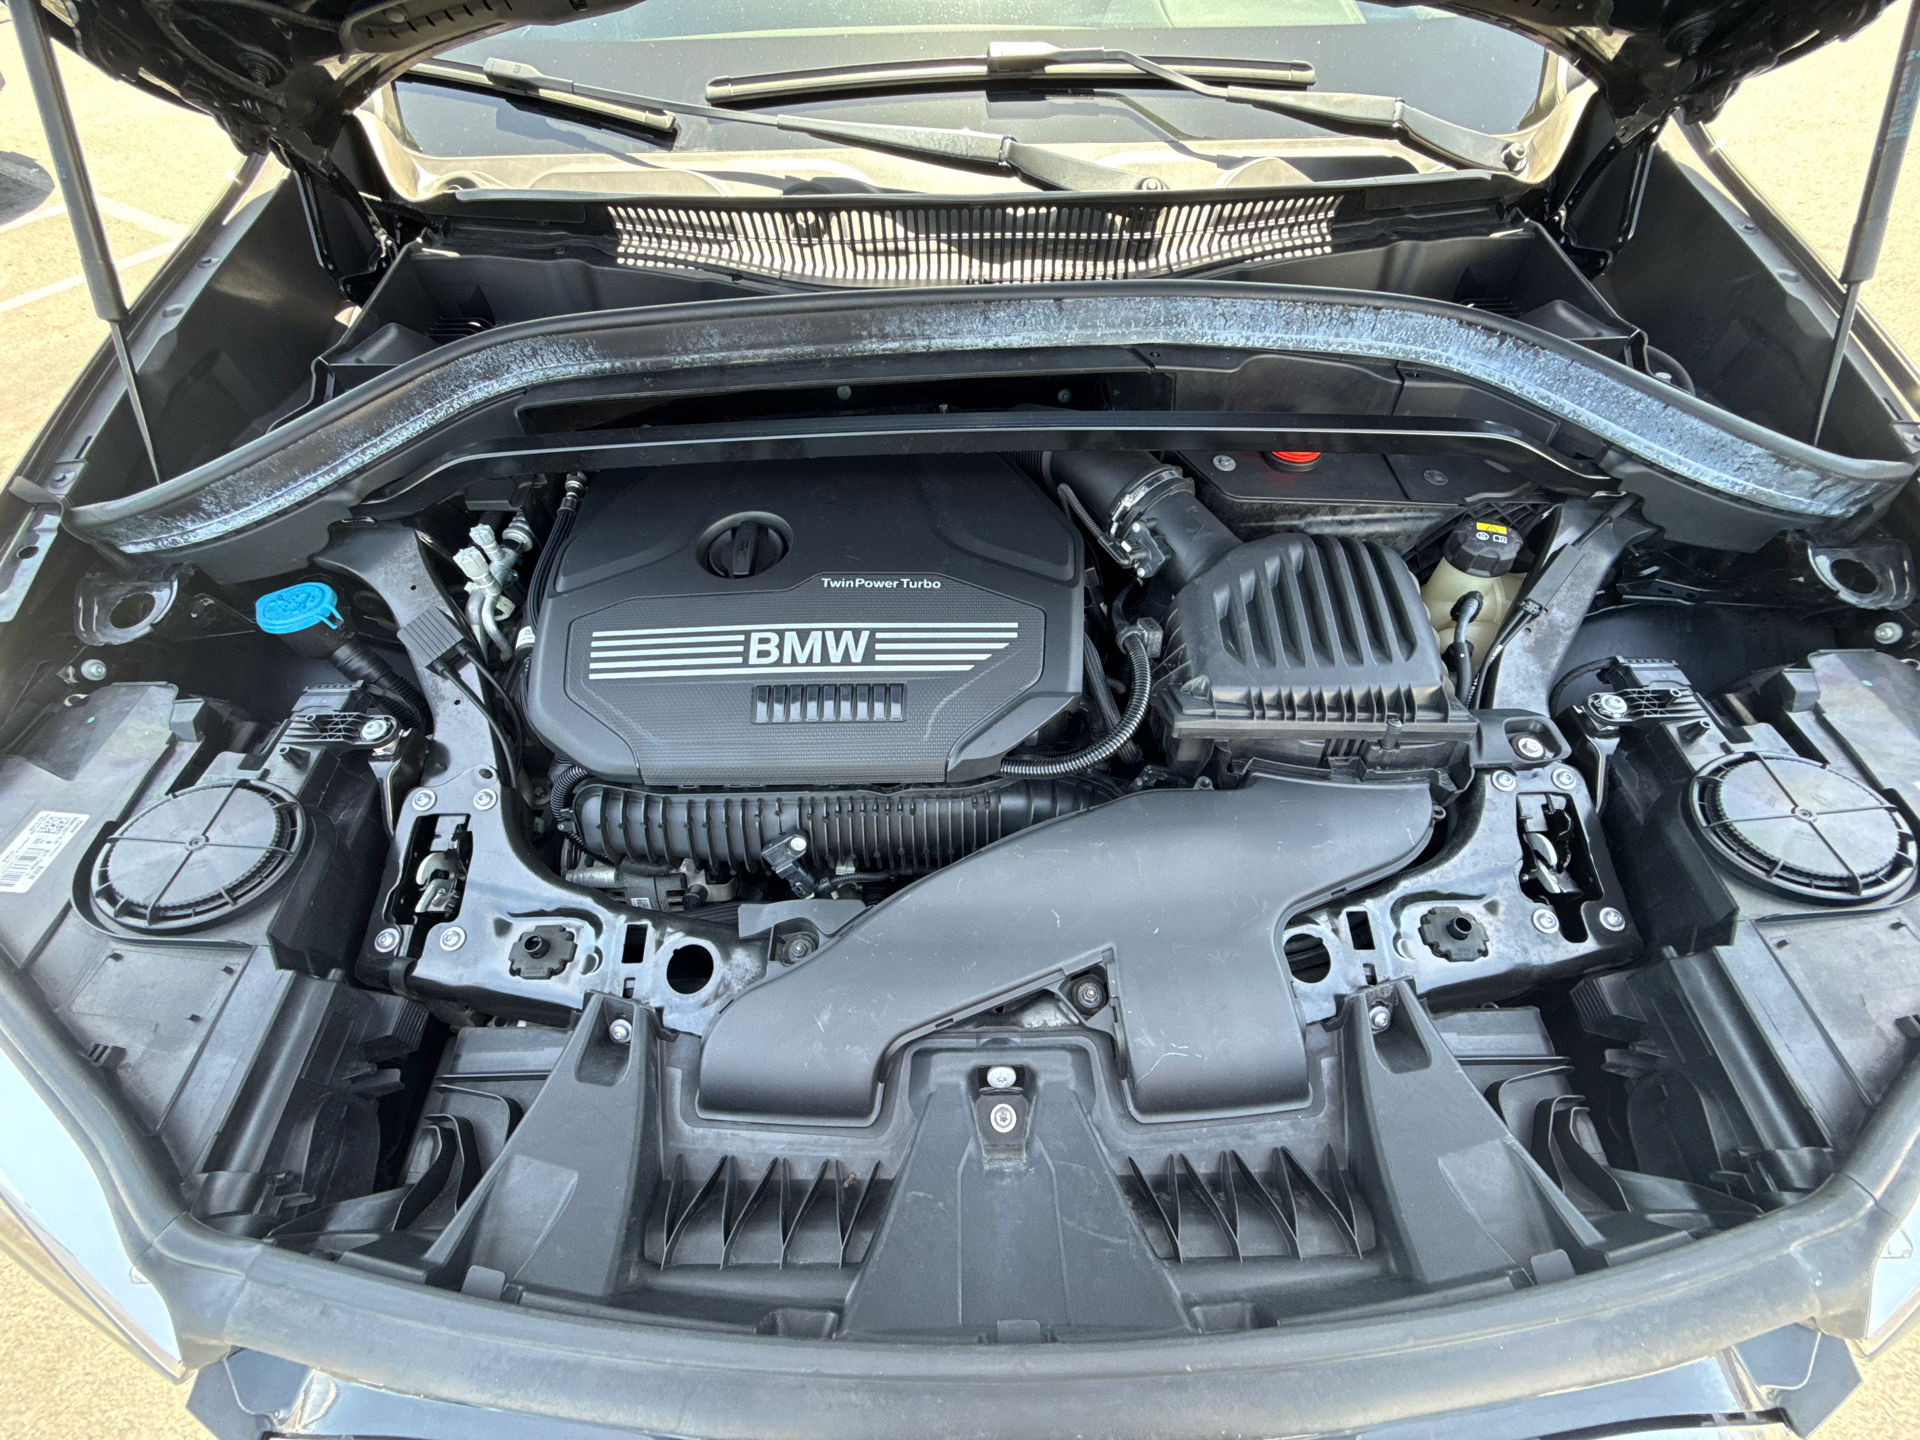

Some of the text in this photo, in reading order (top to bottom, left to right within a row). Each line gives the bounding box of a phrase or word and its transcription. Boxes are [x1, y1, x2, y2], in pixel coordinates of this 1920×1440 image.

[821, 578, 941, 589] TwinPower Turbo
[748, 630, 870, 665] BMW
